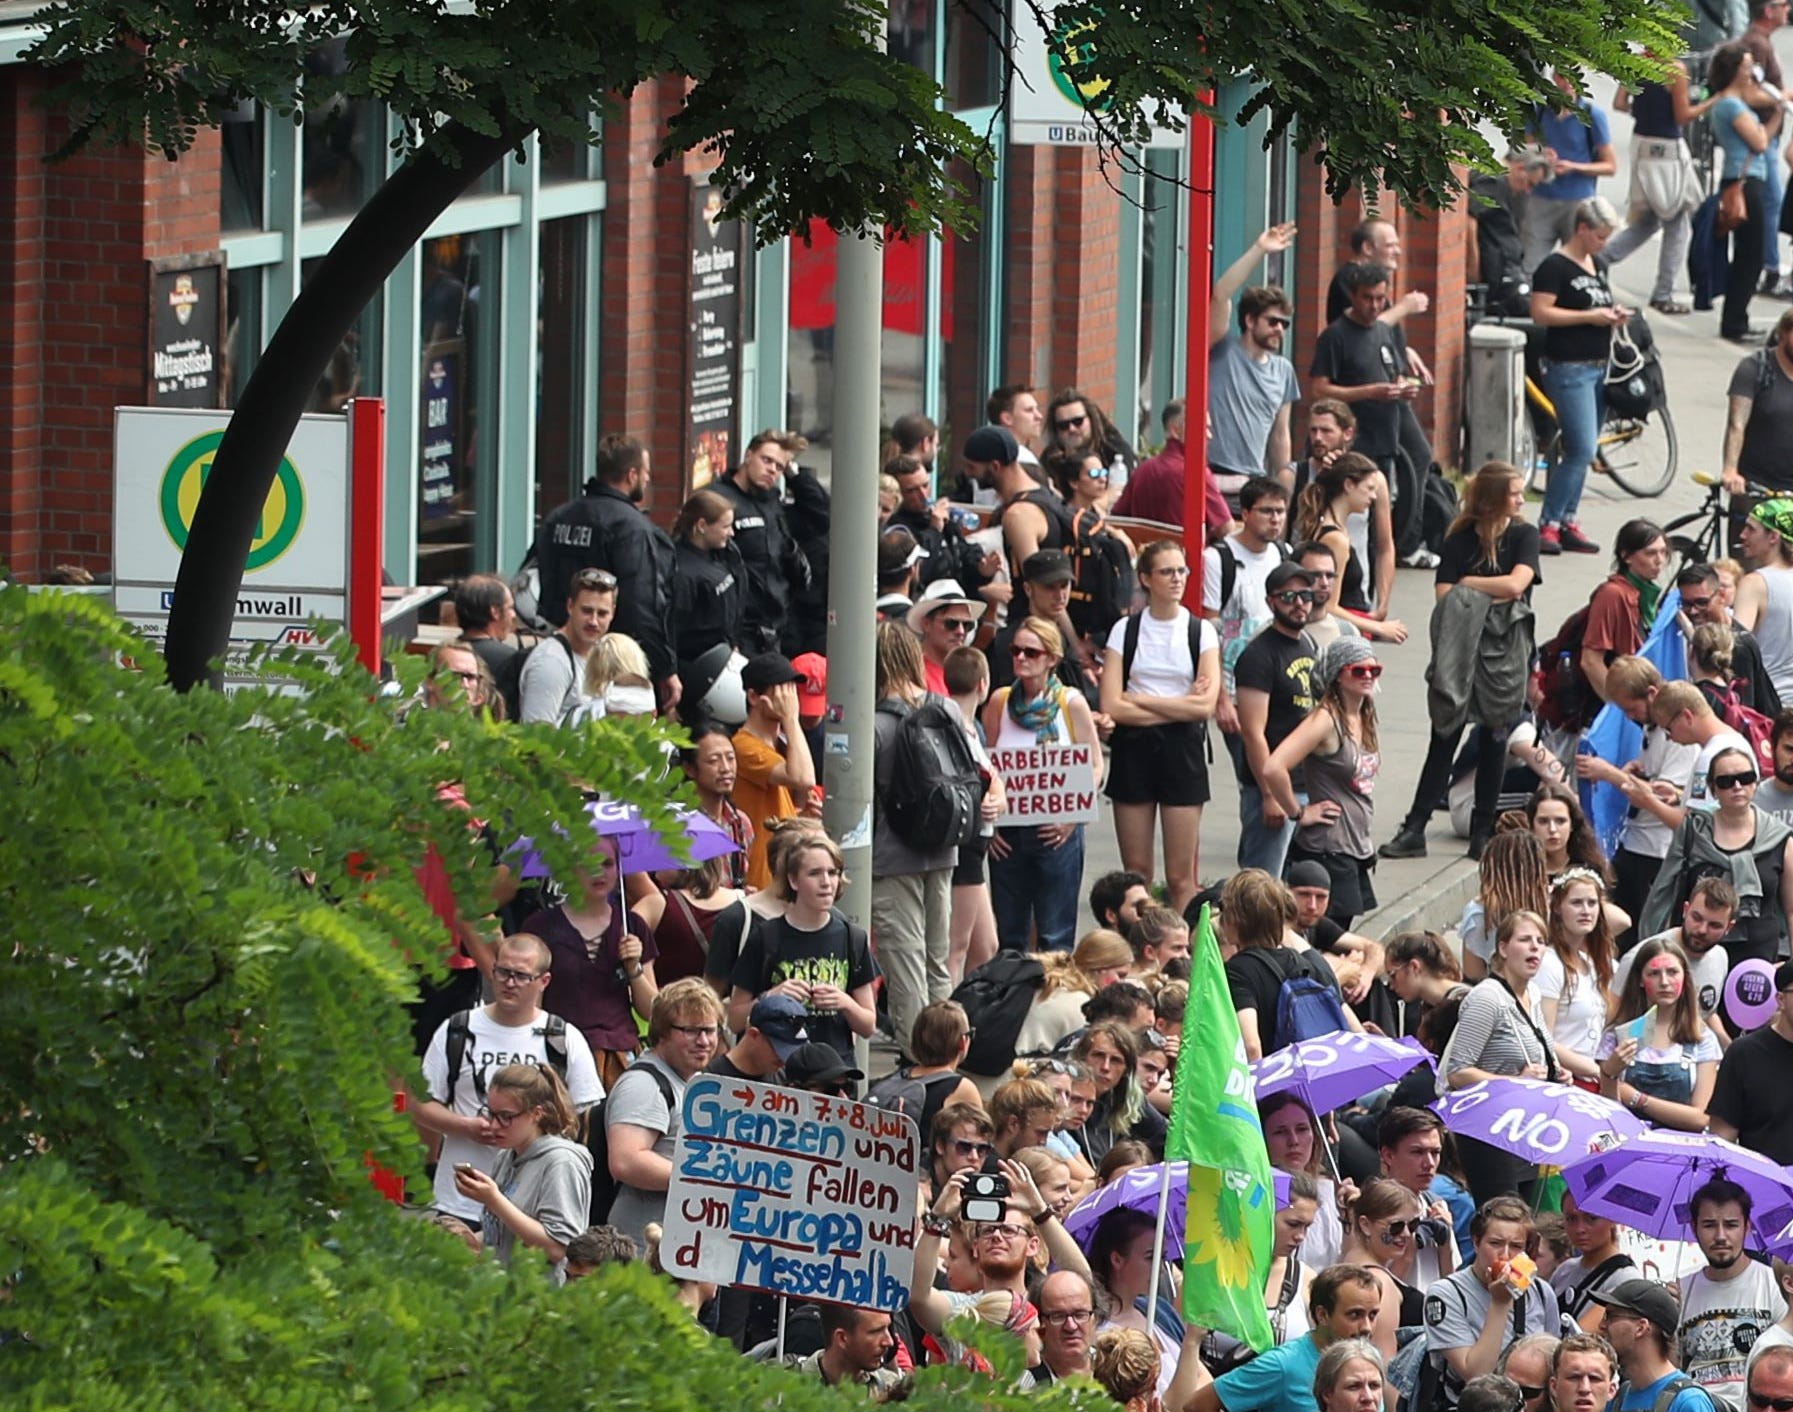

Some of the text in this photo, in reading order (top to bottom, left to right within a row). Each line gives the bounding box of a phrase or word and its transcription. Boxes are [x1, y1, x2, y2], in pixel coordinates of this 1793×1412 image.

[987, 749, 1089, 773] ARBEITEN
[1004, 771, 1066, 791] AUFEN
[1007, 790, 1094, 816] TERBEN
[762, 1090, 800, 1116] am
[681, 1080, 915, 1173] Grenzen und
[1489, 1118, 1569, 1154] NO
[679, 1140, 794, 1192] Zäune
[729, 1191, 863, 1256] Europa
[868, 1215, 916, 1250] und
[735, 1241, 910, 1309] Messehallen
